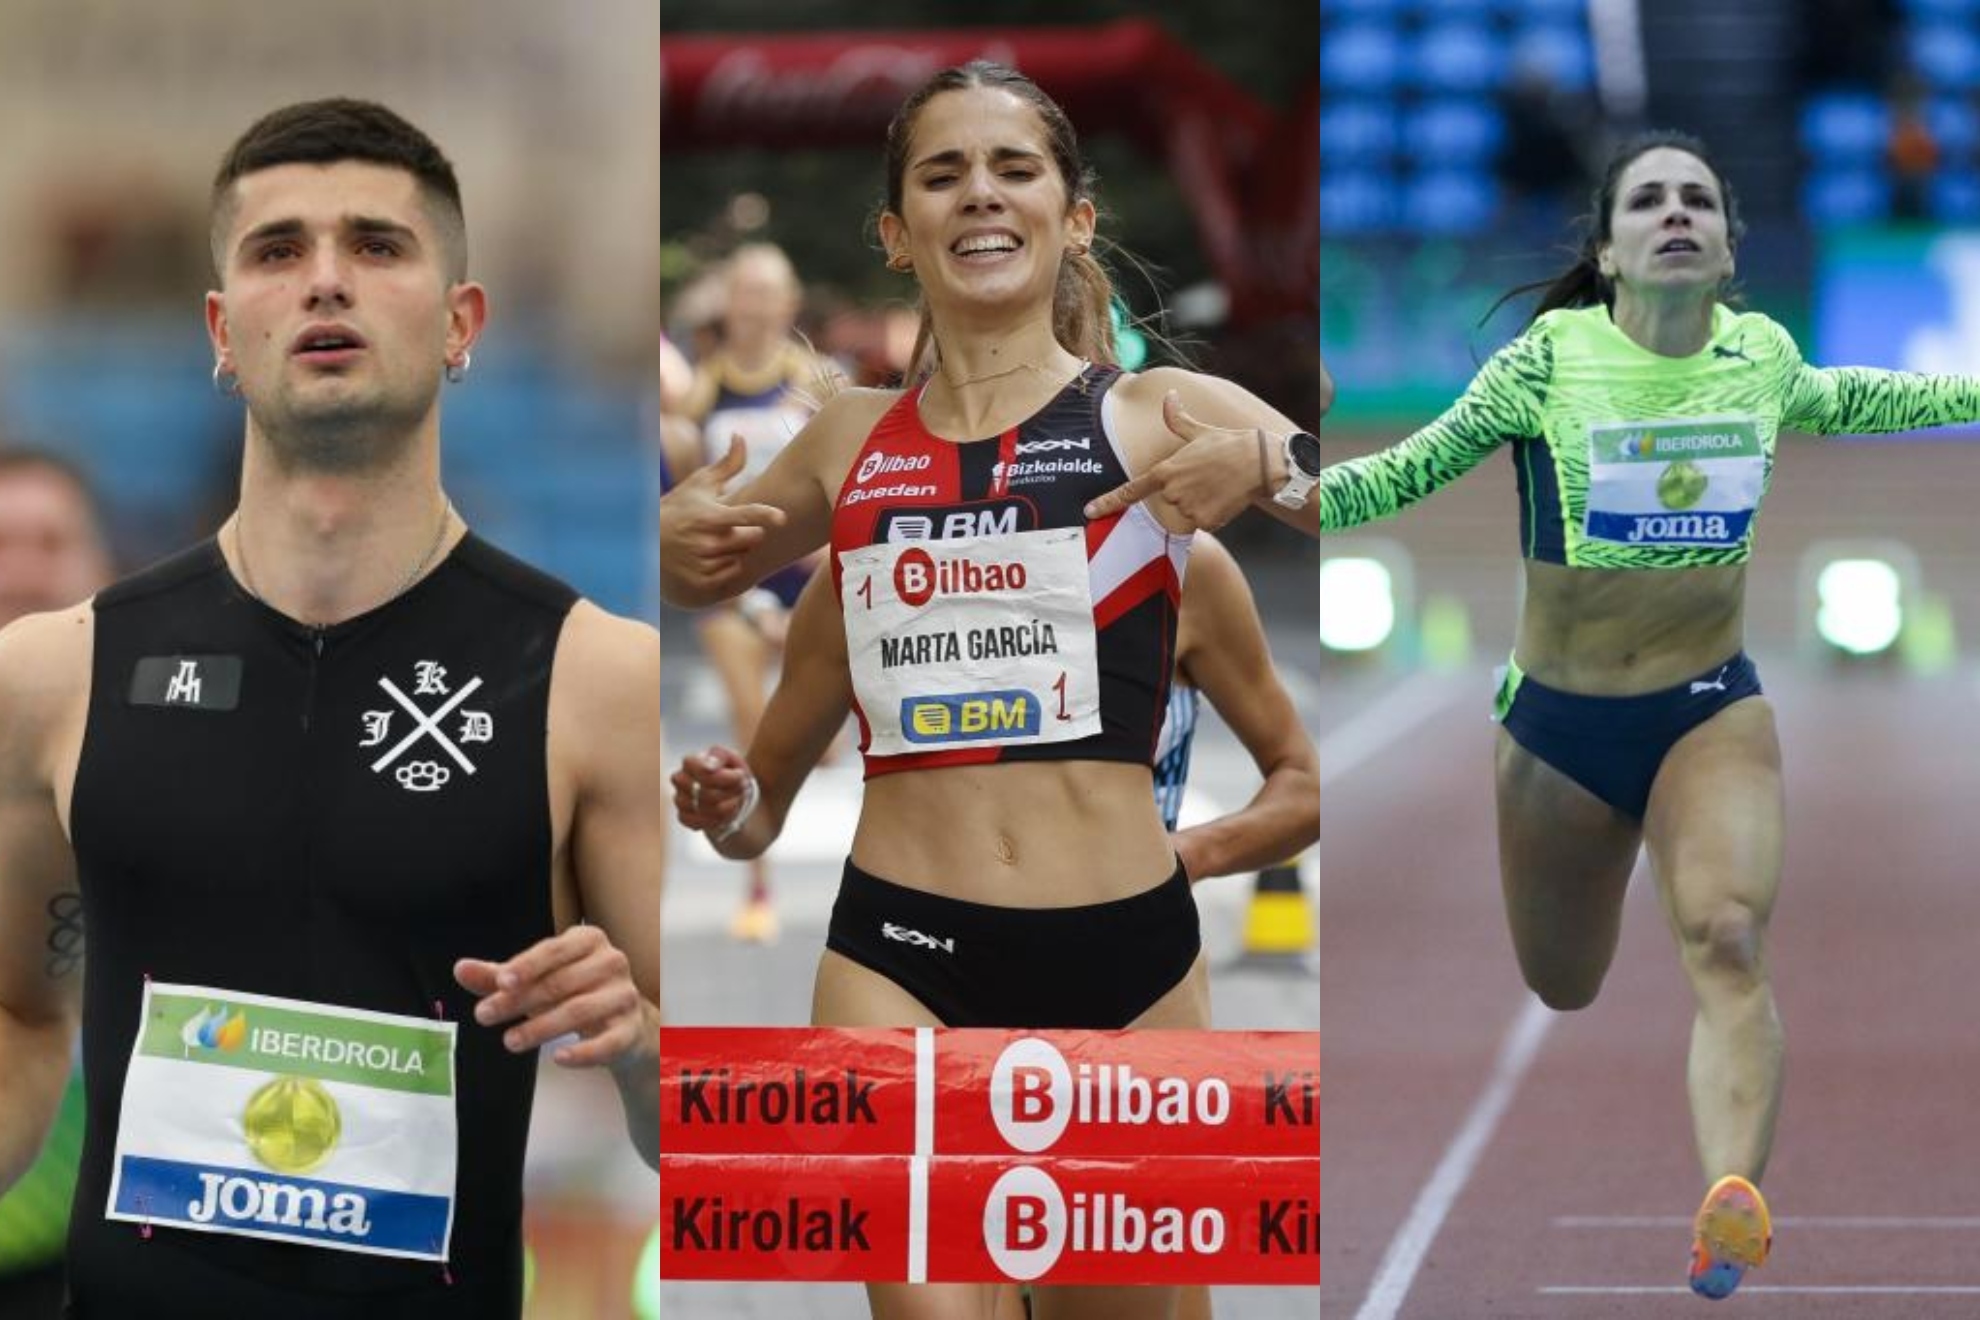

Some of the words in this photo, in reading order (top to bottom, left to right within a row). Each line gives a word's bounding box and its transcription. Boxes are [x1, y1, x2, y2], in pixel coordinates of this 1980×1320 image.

[1656, 433, 1742, 451] IBERDROLA
[860, 454, 931, 477] Bilbao
[1007, 458, 1102, 477] Bizkaialde
[942, 506, 1018, 541] BM
[857, 575, 872, 610] 1
[903, 559, 1026, 594] Bilbao
[881, 631, 961, 668] MARTA
[967, 619, 1058, 660] GARCÍA
[961, 697, 1027, 733] BM
[1052, 671, 1072, 721] 1
[250, 1026, 424, 1076] IBERDROLA
[680, 1068, 878, 1125] Kirolak
[1012, 1064, 1230, 1125] Bilbao
[673, 1197, 871, 1252] Kirolak
[1006, 1193, 1225, 1254] Bilbao
